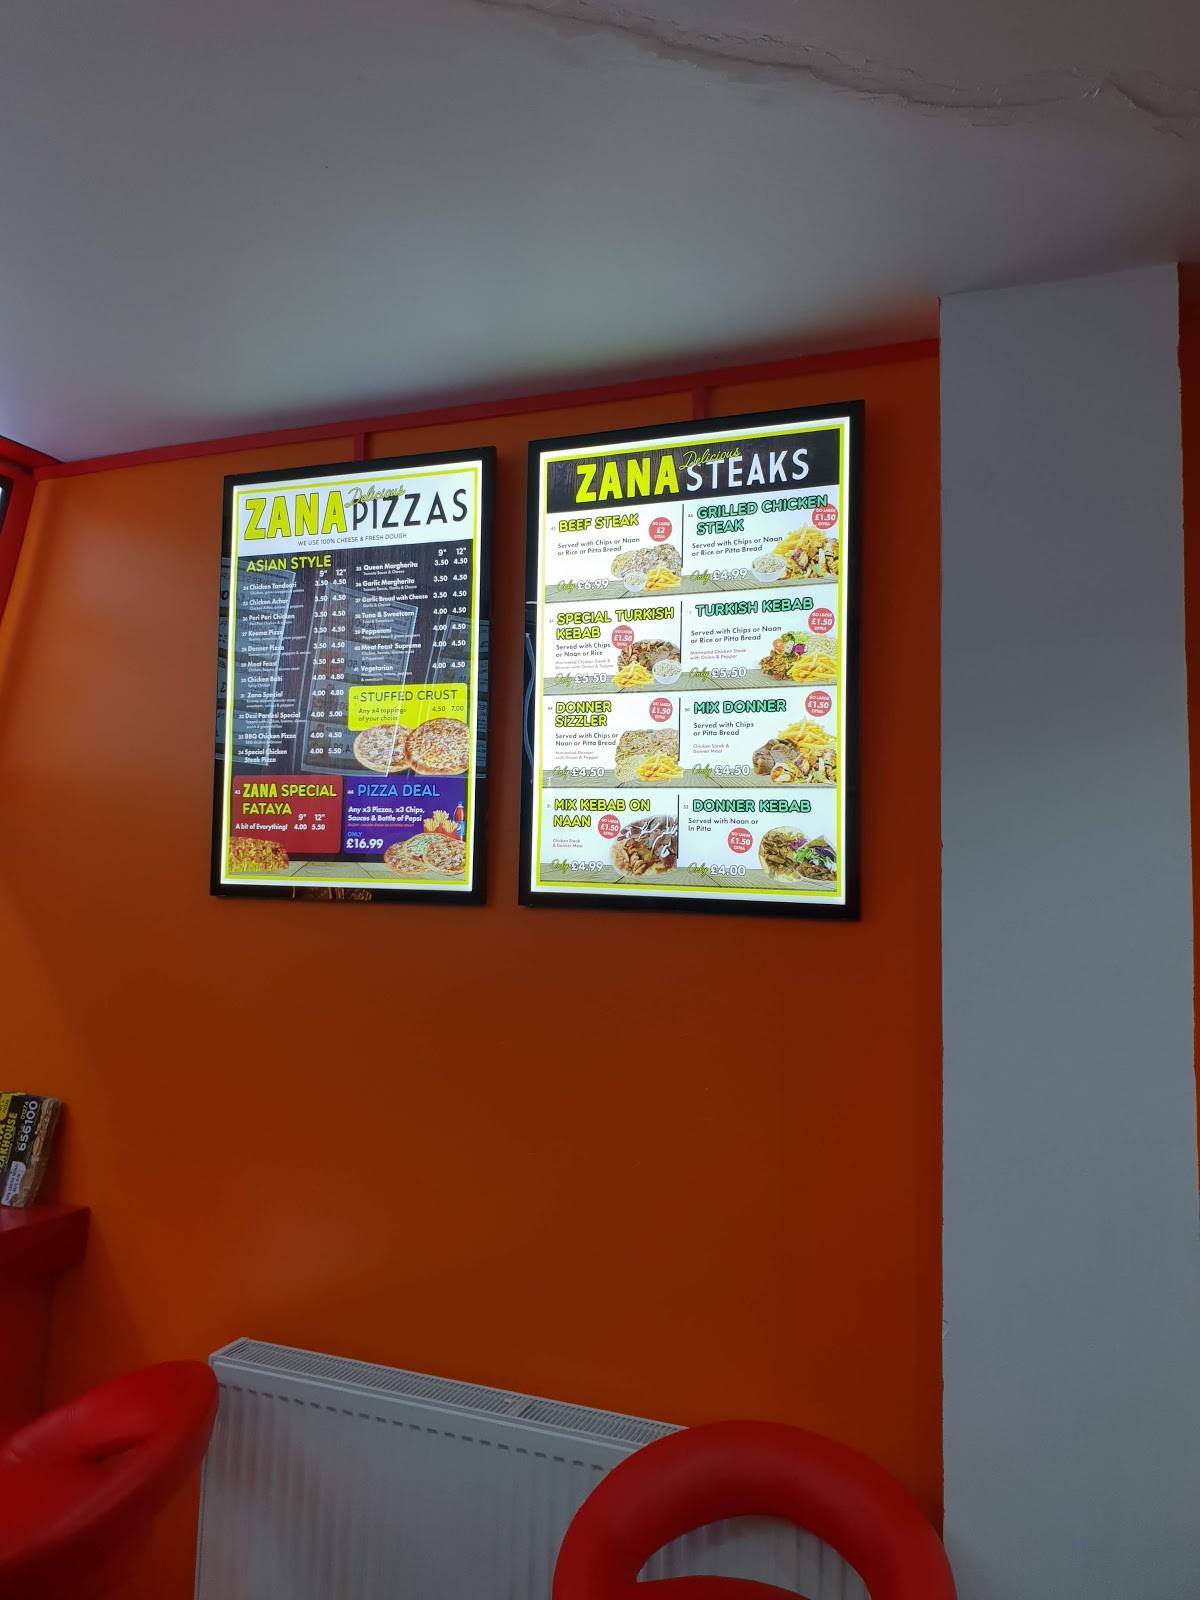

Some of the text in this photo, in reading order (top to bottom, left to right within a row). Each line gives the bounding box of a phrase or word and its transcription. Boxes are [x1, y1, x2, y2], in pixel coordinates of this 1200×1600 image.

[679, 448, 741, 470] Delicious
[686, 448, 809, 492] STEAKS
[576, 455, 679, 503] ZANA
[353, 489, 468, 530] PIZZAS
[697, 494, 828, 520] GRILLED CHICKEN
[244, 490, 347, 540] ZANA
[559, 513, 639, 532] BEEF STEAK
[697, 519, 744, 535] STEAK
[337, 535, 359, 543] CHEESE
[558, 541, 579, 549] Served
[596, 539, 612, 547] Chips
[692, 541, 716, 549] Served
[733, 538, 751, 546] Chips
[701, 548, 714, 556] Rice
[246, 555, 332, 572] ASIAN STYLE
[364, 561, 418, 571] Queen Margherita
[712, 568, 748, 581] £4.99
[381, 578, 415, 586] Margherita
[577, 579, 609, 590] £6.99
[695, 597, 813, 618] TURKISH KEBAB
[557, 606, 674, 625] SPECIAL TURKISH
[556, 626, 601, 640] KEBAB
[575, 673, 607, 683] £5.50
[711, 667, 746, 679] £5.50
[360, 689, 457, 702] STUFFED CRUST
[359, 708, 370, 716] Any
[556, 700, 611, 714] DONNER
[694, 699, 787, 714] MIX DONNER
[555, 714, 607, 727] SIZZLER
[571, 767, 604, 777] £4.50
[713, 765, 750, 776] £4.50
[243, 784, 337, 798] ZANA SPECIAL
[358, 784, 440, 796] PIZZA DEAL
[243, 803, 292, 815] FATAYA
[406, 806, 425, 814] Chips,
[554, 798, 650, 811] MIX KEBAB ON
[693, 799, 811, 813] DONNER KEBAB
[553, 815, 592, 827] NAAN
[346, 839, 383, 848] £16.99
[571, 860, 603, 872] £4.99
[710, 864, 746, 876] £4.00
[18, 1100, 38, 1152] 656100
